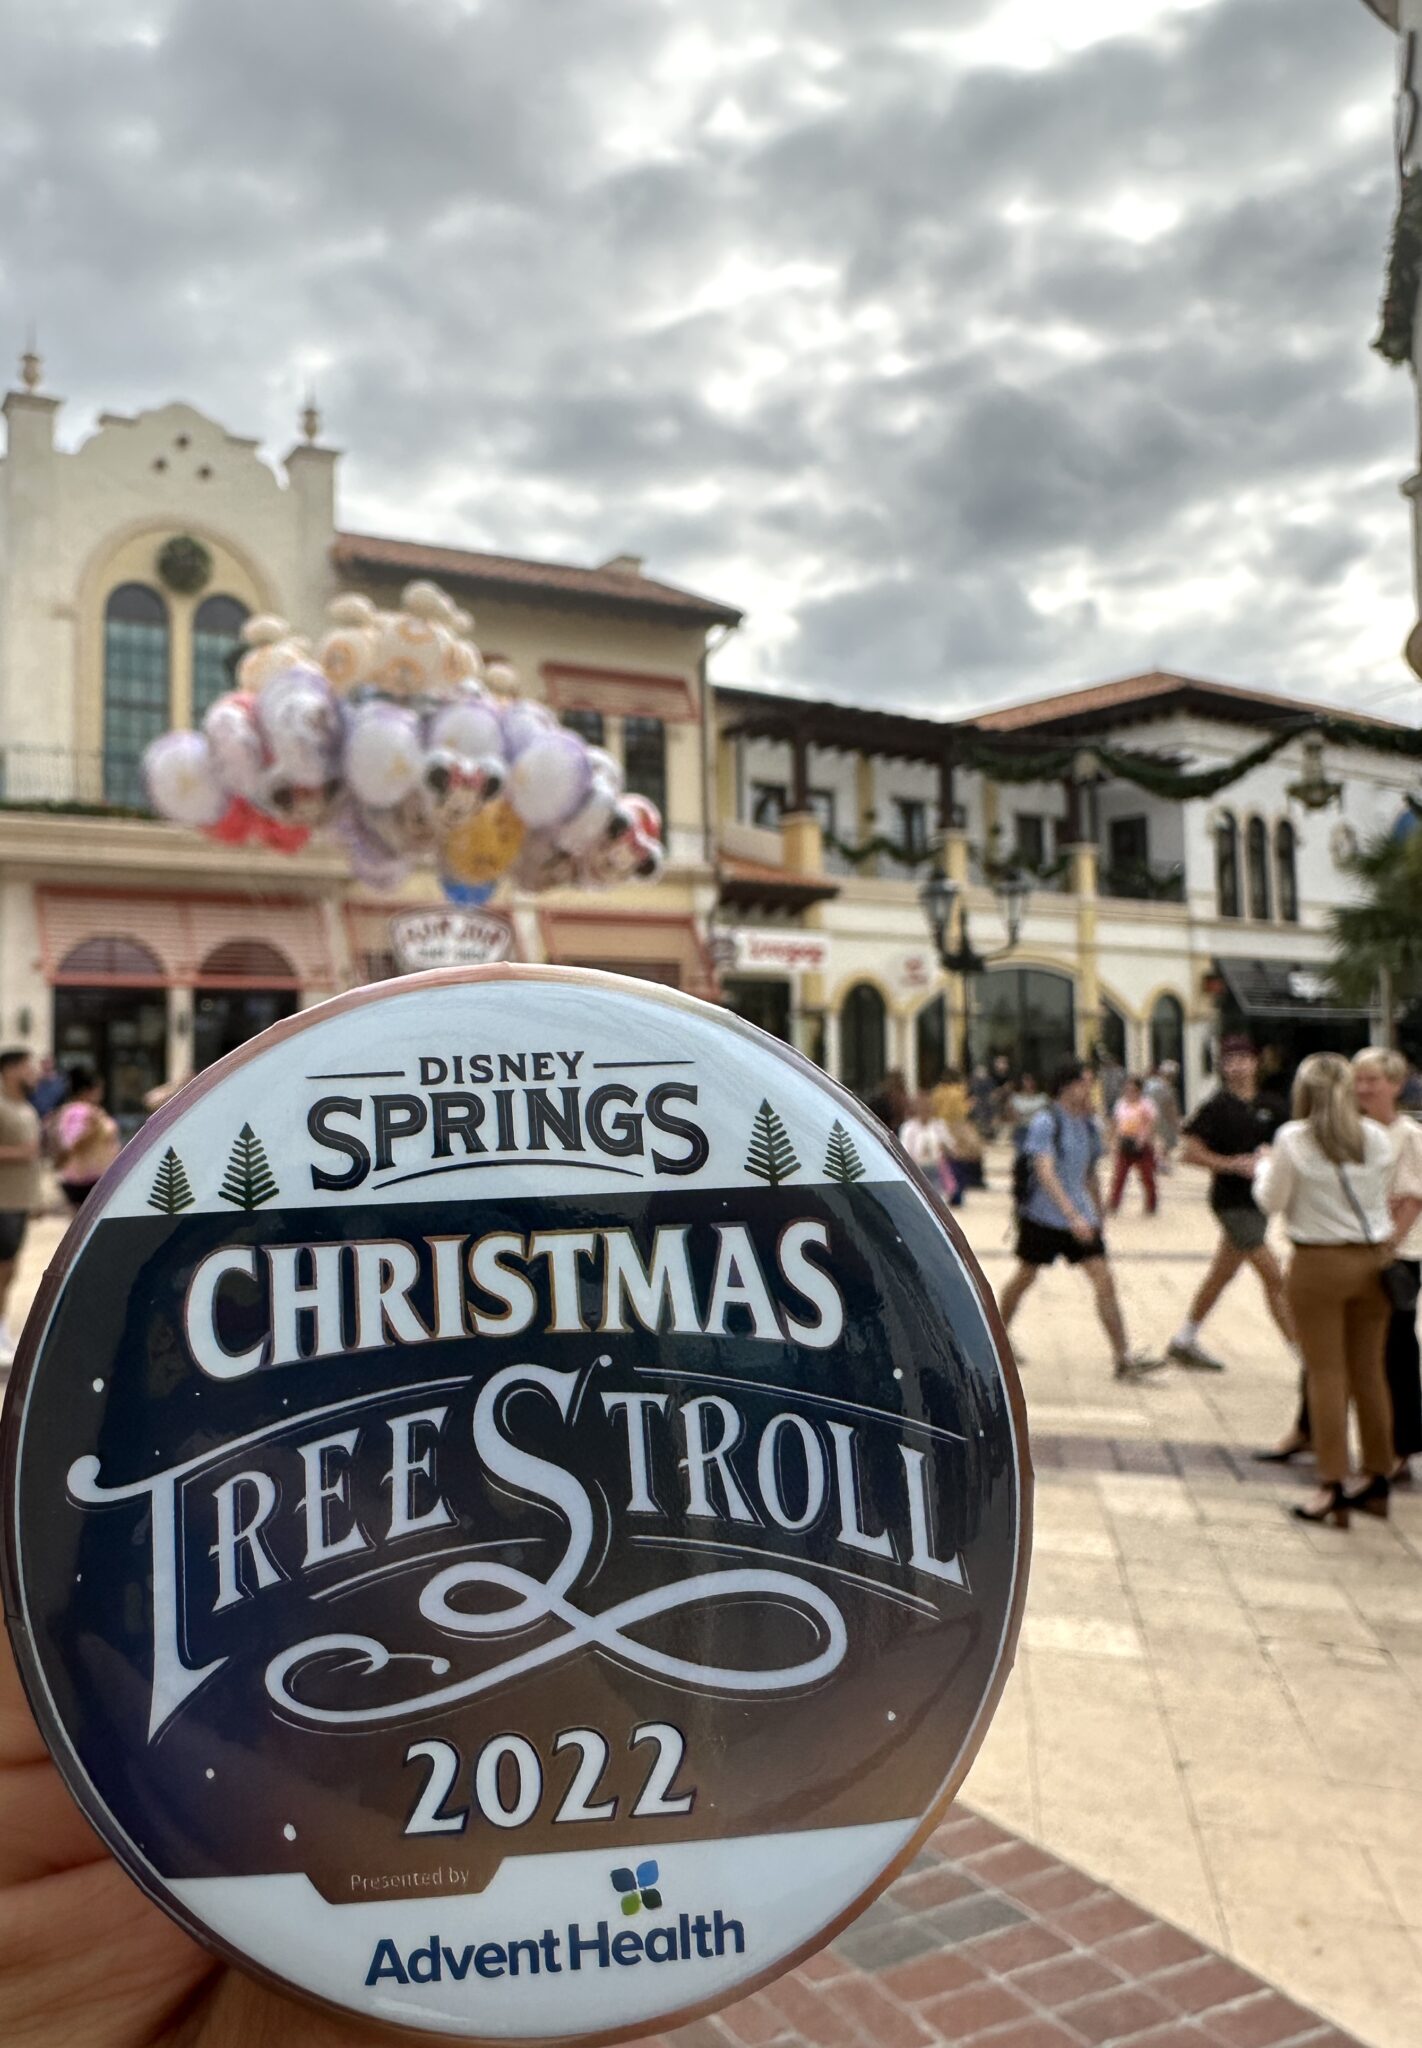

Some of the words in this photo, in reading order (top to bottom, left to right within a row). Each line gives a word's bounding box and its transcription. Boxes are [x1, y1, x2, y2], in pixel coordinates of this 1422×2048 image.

[420, 1051, 585, 1086] DISNEY
[307, 1084, 710, 1191] SPRINGS
[184, 1218, 846, 1381] CHRISTMAS
[66, 1407, 460, 1745] TREE
[404, 1722, 696, 1837] 2022
[350, 1867, 443, 1892] Presented
[449, 1866, 470, 1889] by
